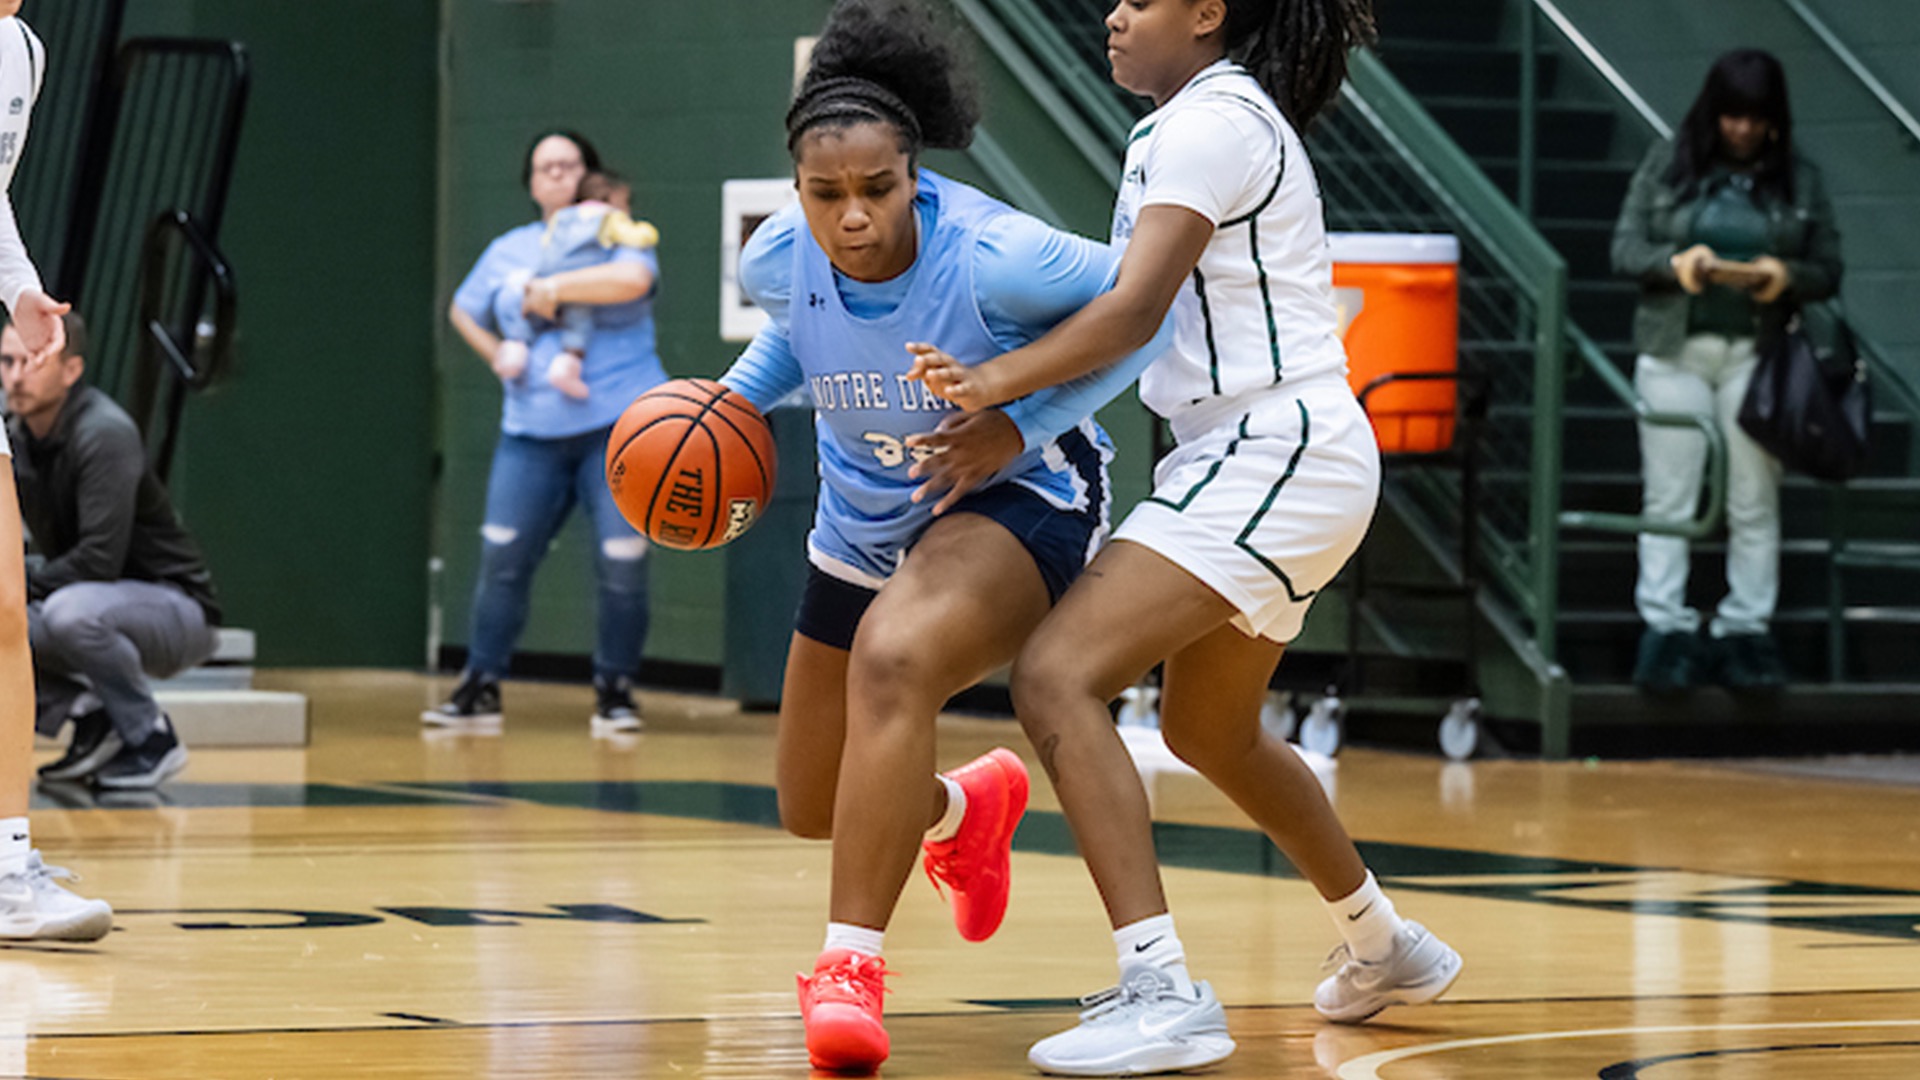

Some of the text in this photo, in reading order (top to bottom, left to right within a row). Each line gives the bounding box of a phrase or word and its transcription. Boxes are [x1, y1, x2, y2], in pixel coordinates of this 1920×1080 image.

[809, 373, 953, 411] NOTRE DA
[665, 467, 703, 518] THE
